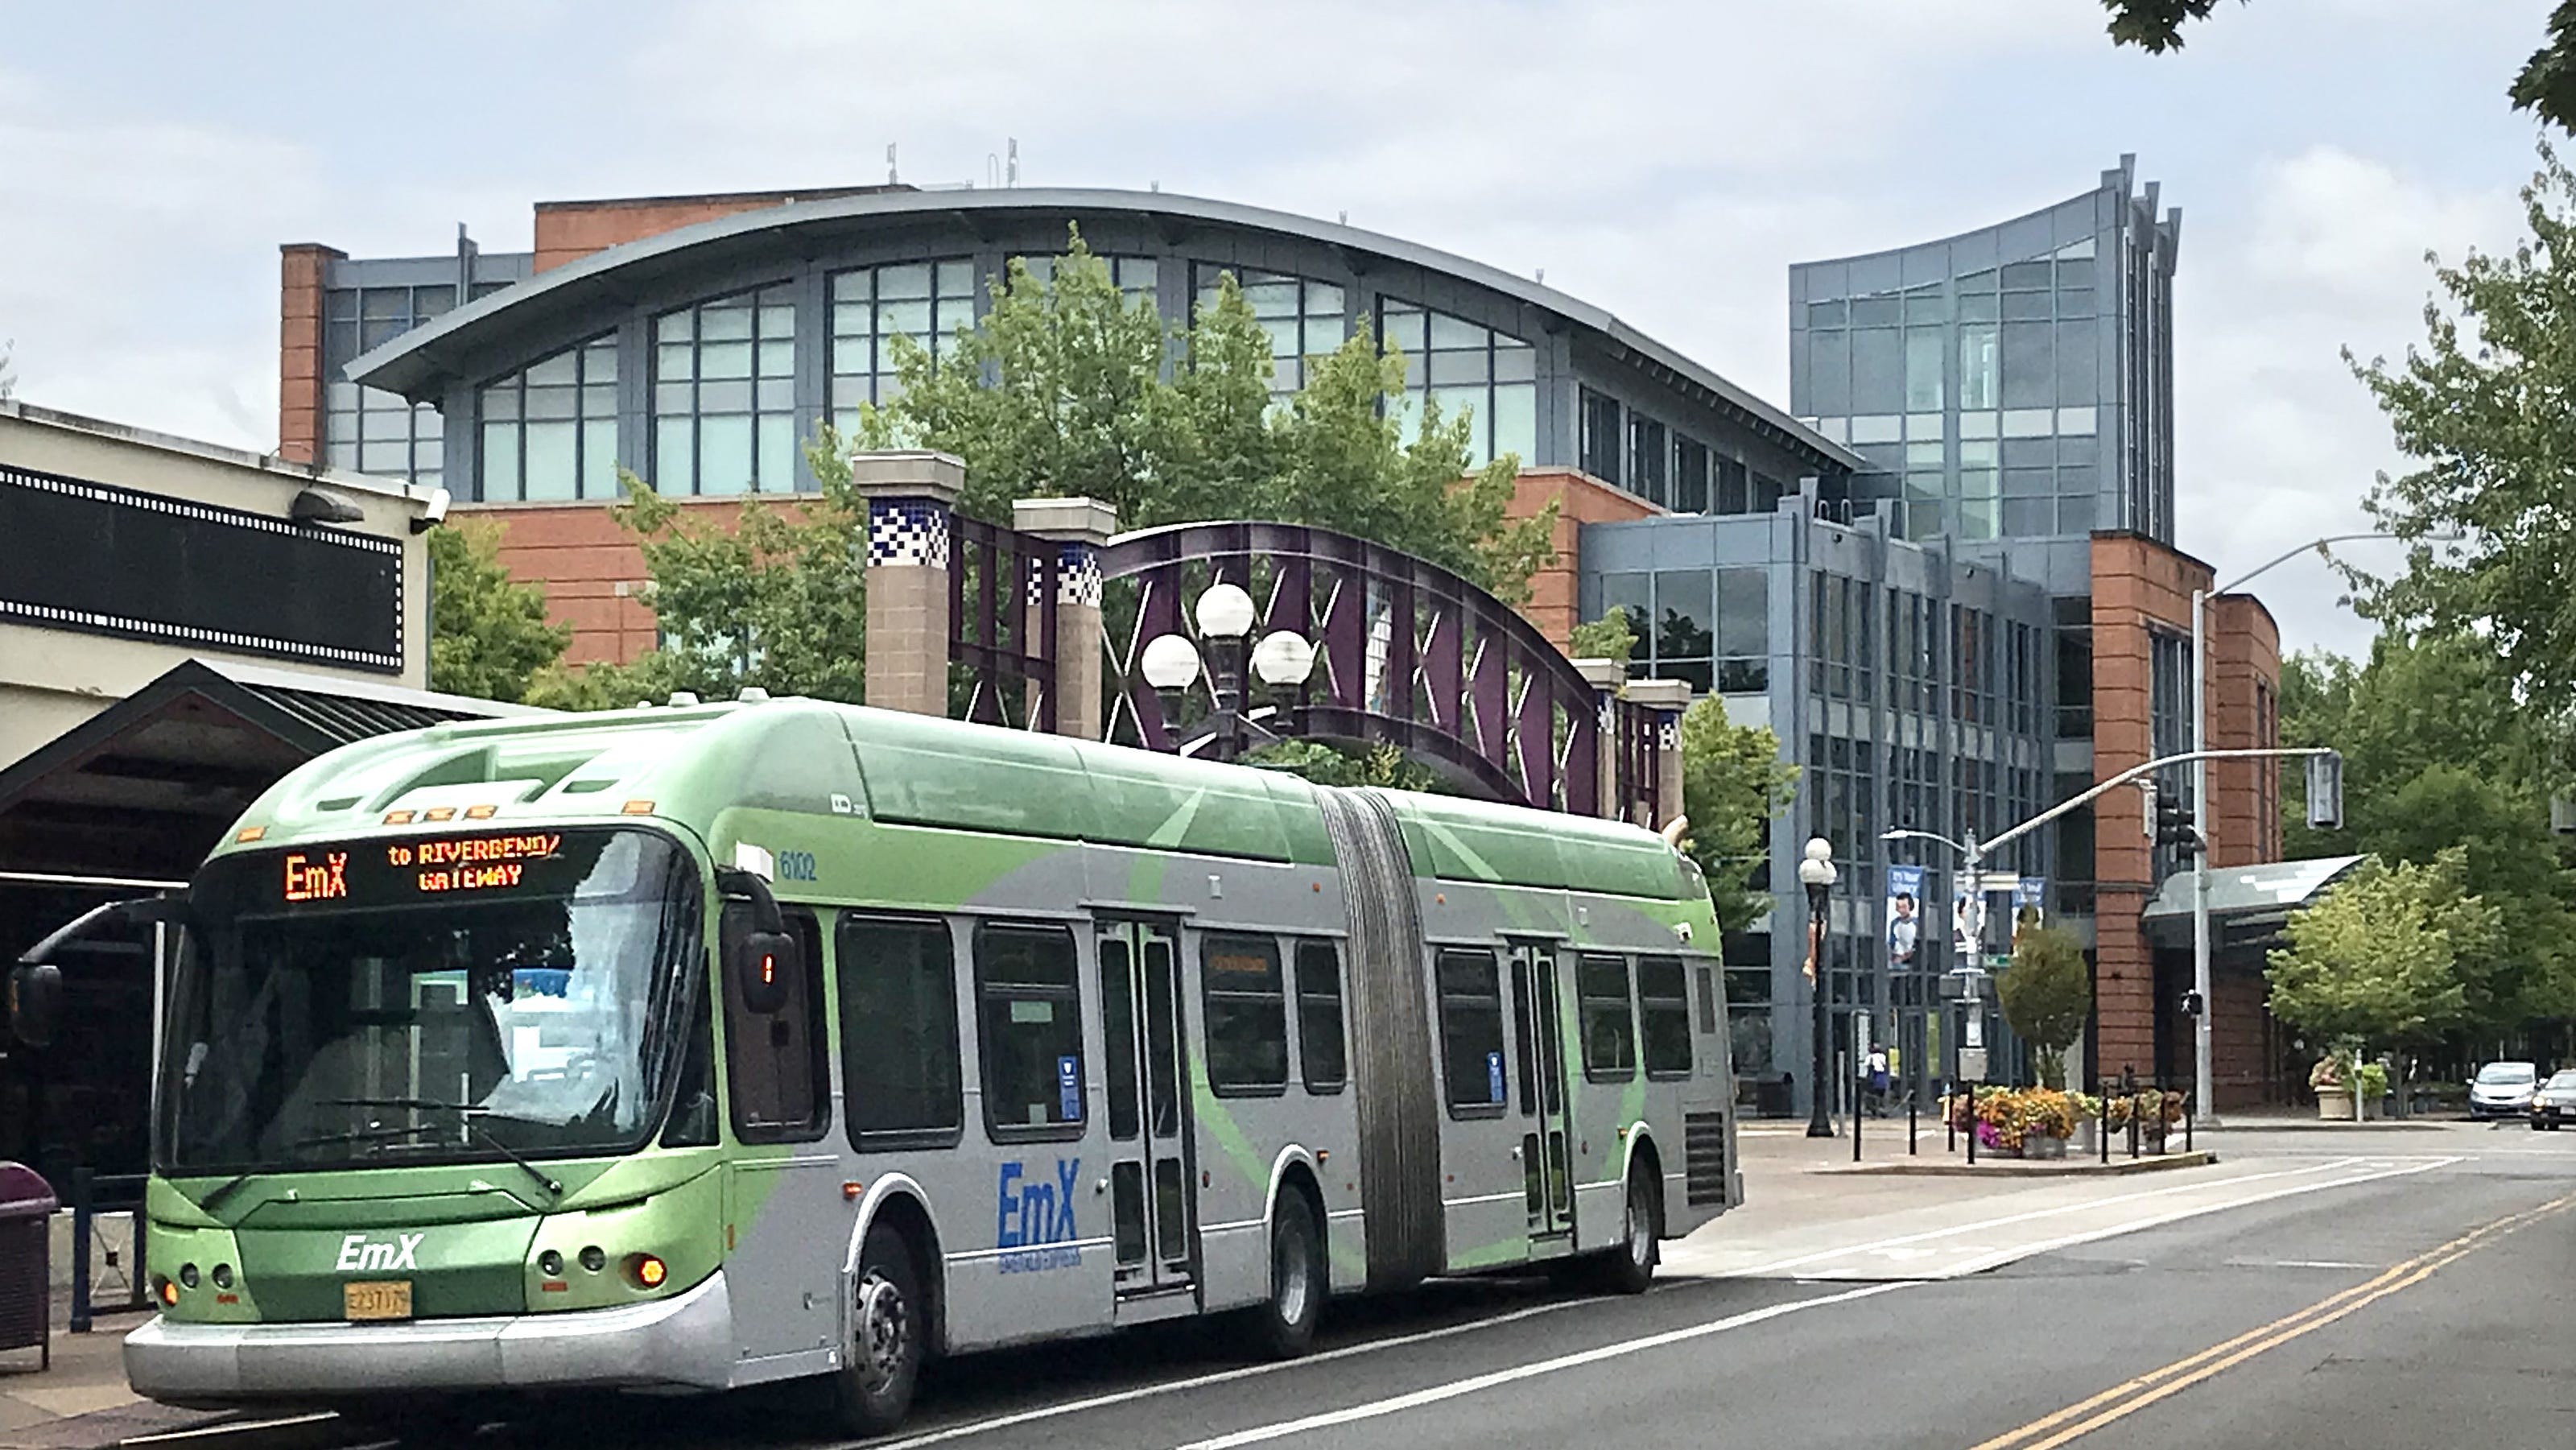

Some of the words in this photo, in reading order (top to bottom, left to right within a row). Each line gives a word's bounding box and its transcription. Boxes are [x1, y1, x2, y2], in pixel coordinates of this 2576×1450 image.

[388, 845, 412, 865] to
[780, 850, 817, 881] 6102
[285, 852, 348, 900] EmX
[419, 864, 522, 890] GATEWAY
[998, 1157, 1080, 1249] EmX
[336, 1233, 424, 1270] EmX
